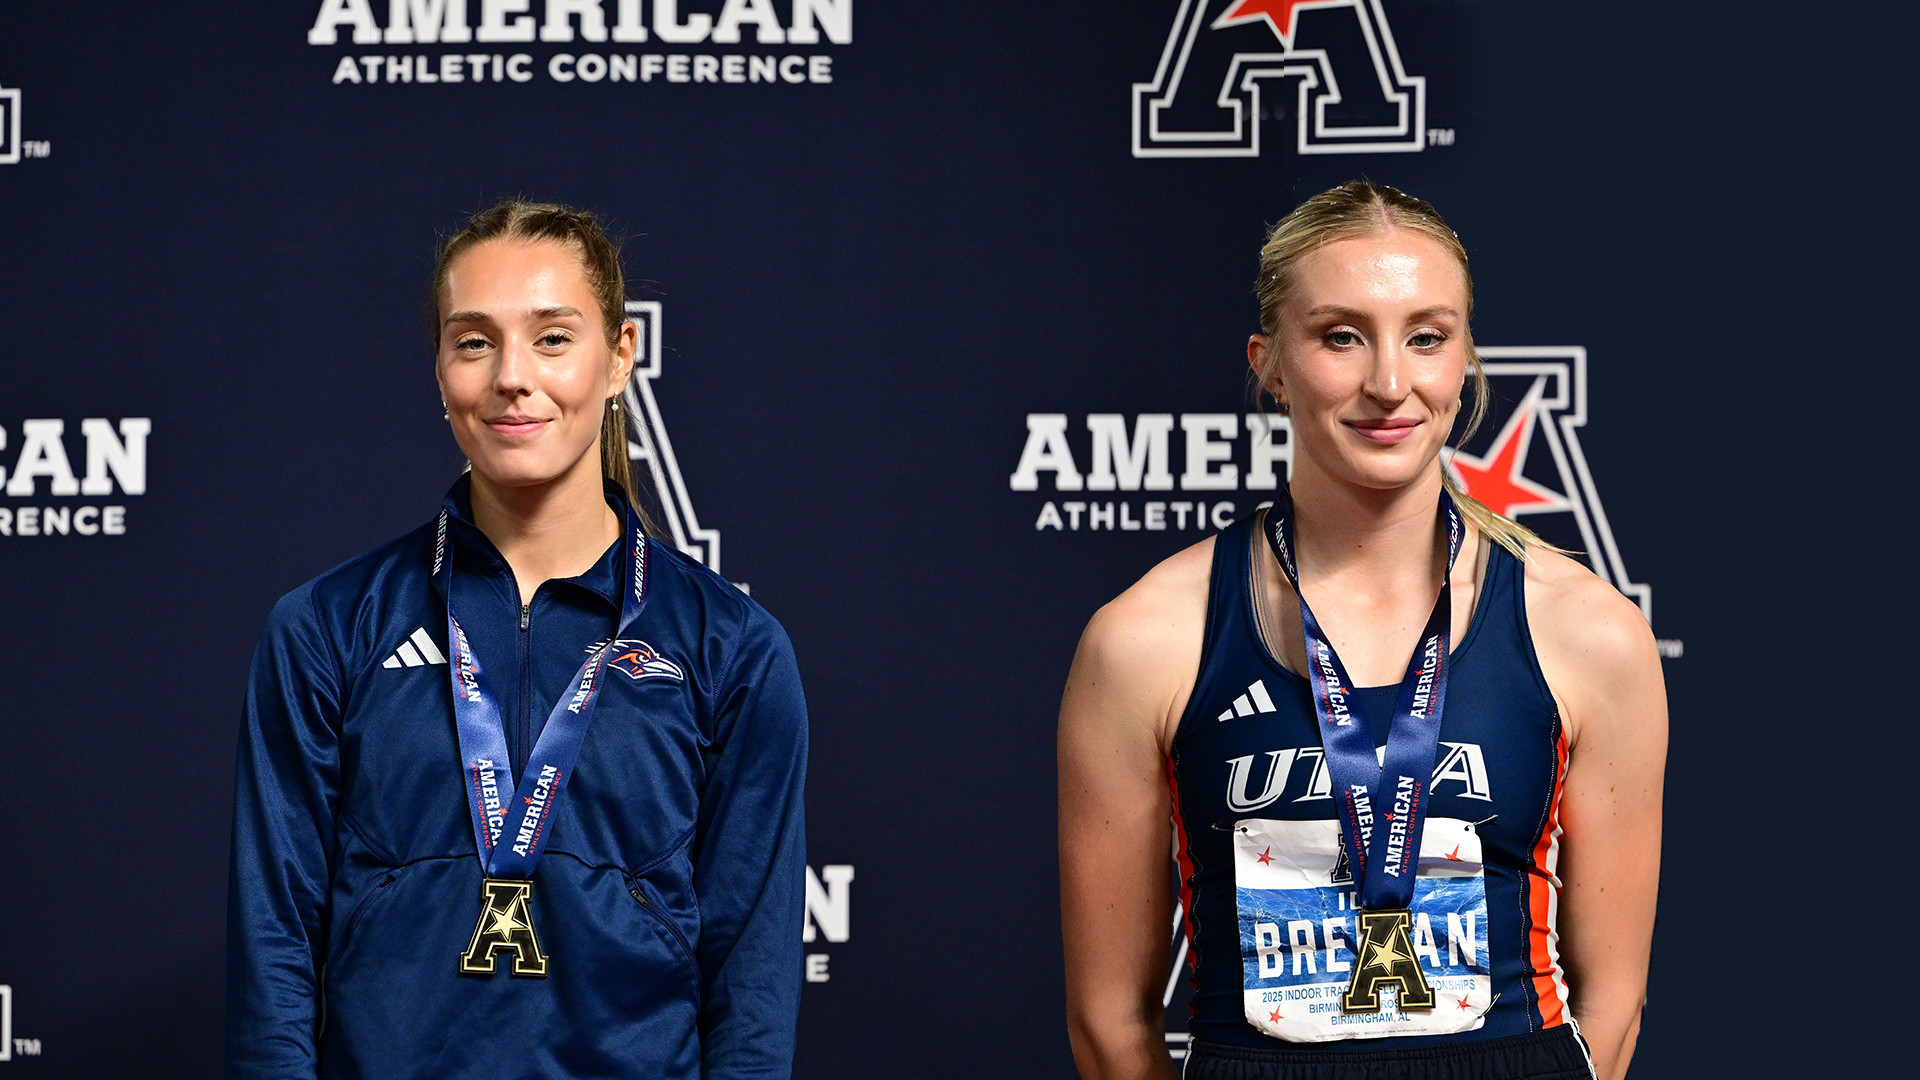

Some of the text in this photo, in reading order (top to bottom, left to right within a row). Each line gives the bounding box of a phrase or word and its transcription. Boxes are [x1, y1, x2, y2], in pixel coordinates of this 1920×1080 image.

[308, 0, 853, 44] AMERICAN
[333, 54, 833, 84] ATHLETIC CONFERENCE
[0, 417, 152, 496] AN
[1035, 502, 1235, 530] ATHLETIC
[634, 528, 646, 603] AMERICAN
[1316, 638, 1352, 727] AMERICAN
[1410, 634, 1439, 720] AMERICAN
[470, 763, 492, 850] ATHLETIC CONFERENCE
[478, 758, 505, 847] AMERICA
[512, 764, 558, 858] AMERICAN
[528, 771, 563, 855] ATHLETIC CONFERENCE
[1343, 790, 1357, 828] ATHLETIC
[1383, 775, 1415, 878] AMERICAN
[1401, 781, 1422, 874] ATHLETIC CONFERENCE
[1262, 990, 1283, 1003] 2025
[1285, 987, 1322, 1001] INDOOR
[1331, 1012, 1411, 1026] BIRMINGHAM, AL
